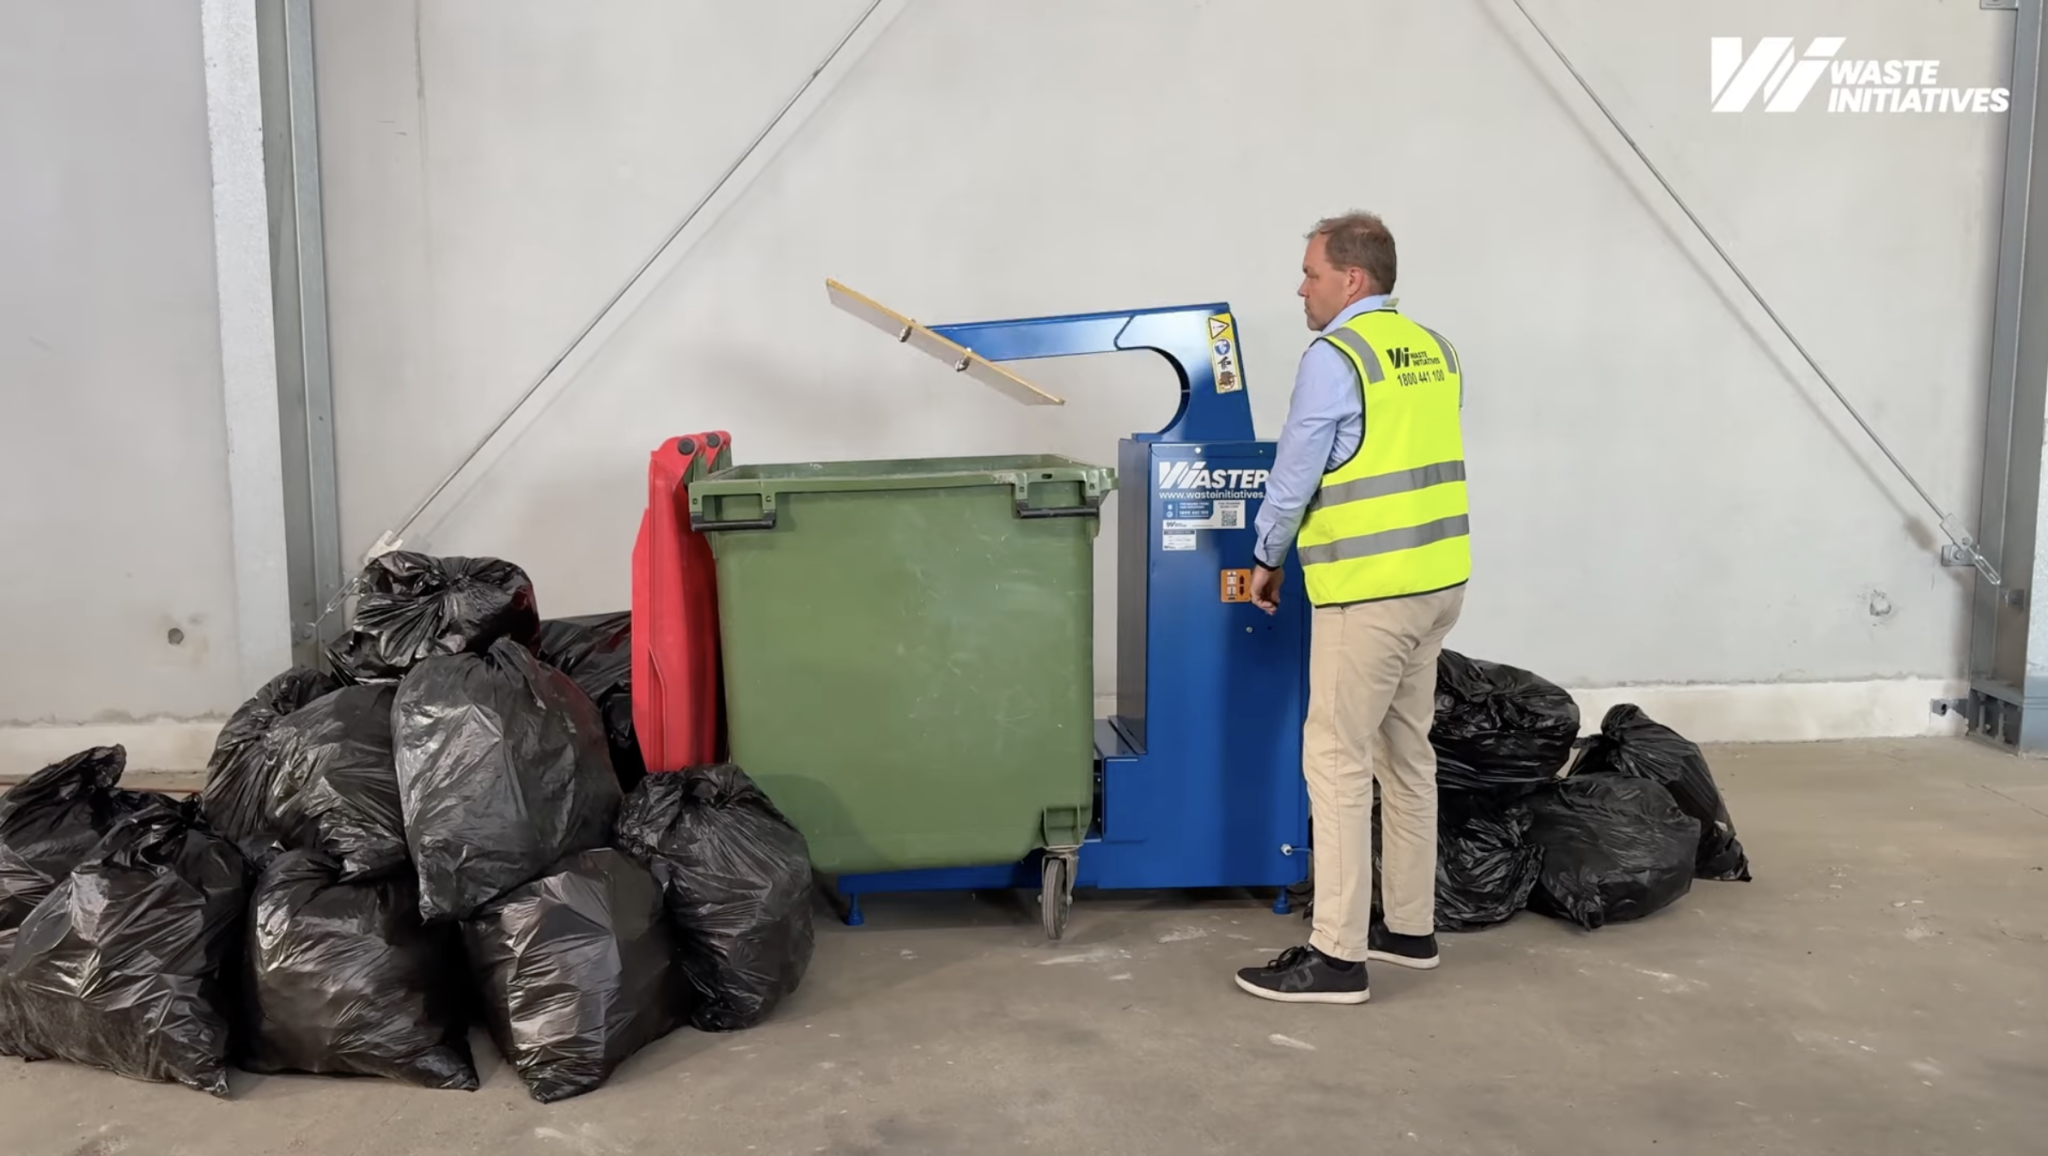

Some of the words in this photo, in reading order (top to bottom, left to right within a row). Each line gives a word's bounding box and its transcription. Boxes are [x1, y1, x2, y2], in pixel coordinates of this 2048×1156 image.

[1410, 351, 1428, 359] WASTE
[1412, 357, 1441, 366] INITIATIVES
[1397, 372, 1418, 387] 1800
[1418, 371, 1431, 383] 441
[1432, 369, 1445, 382] 100
